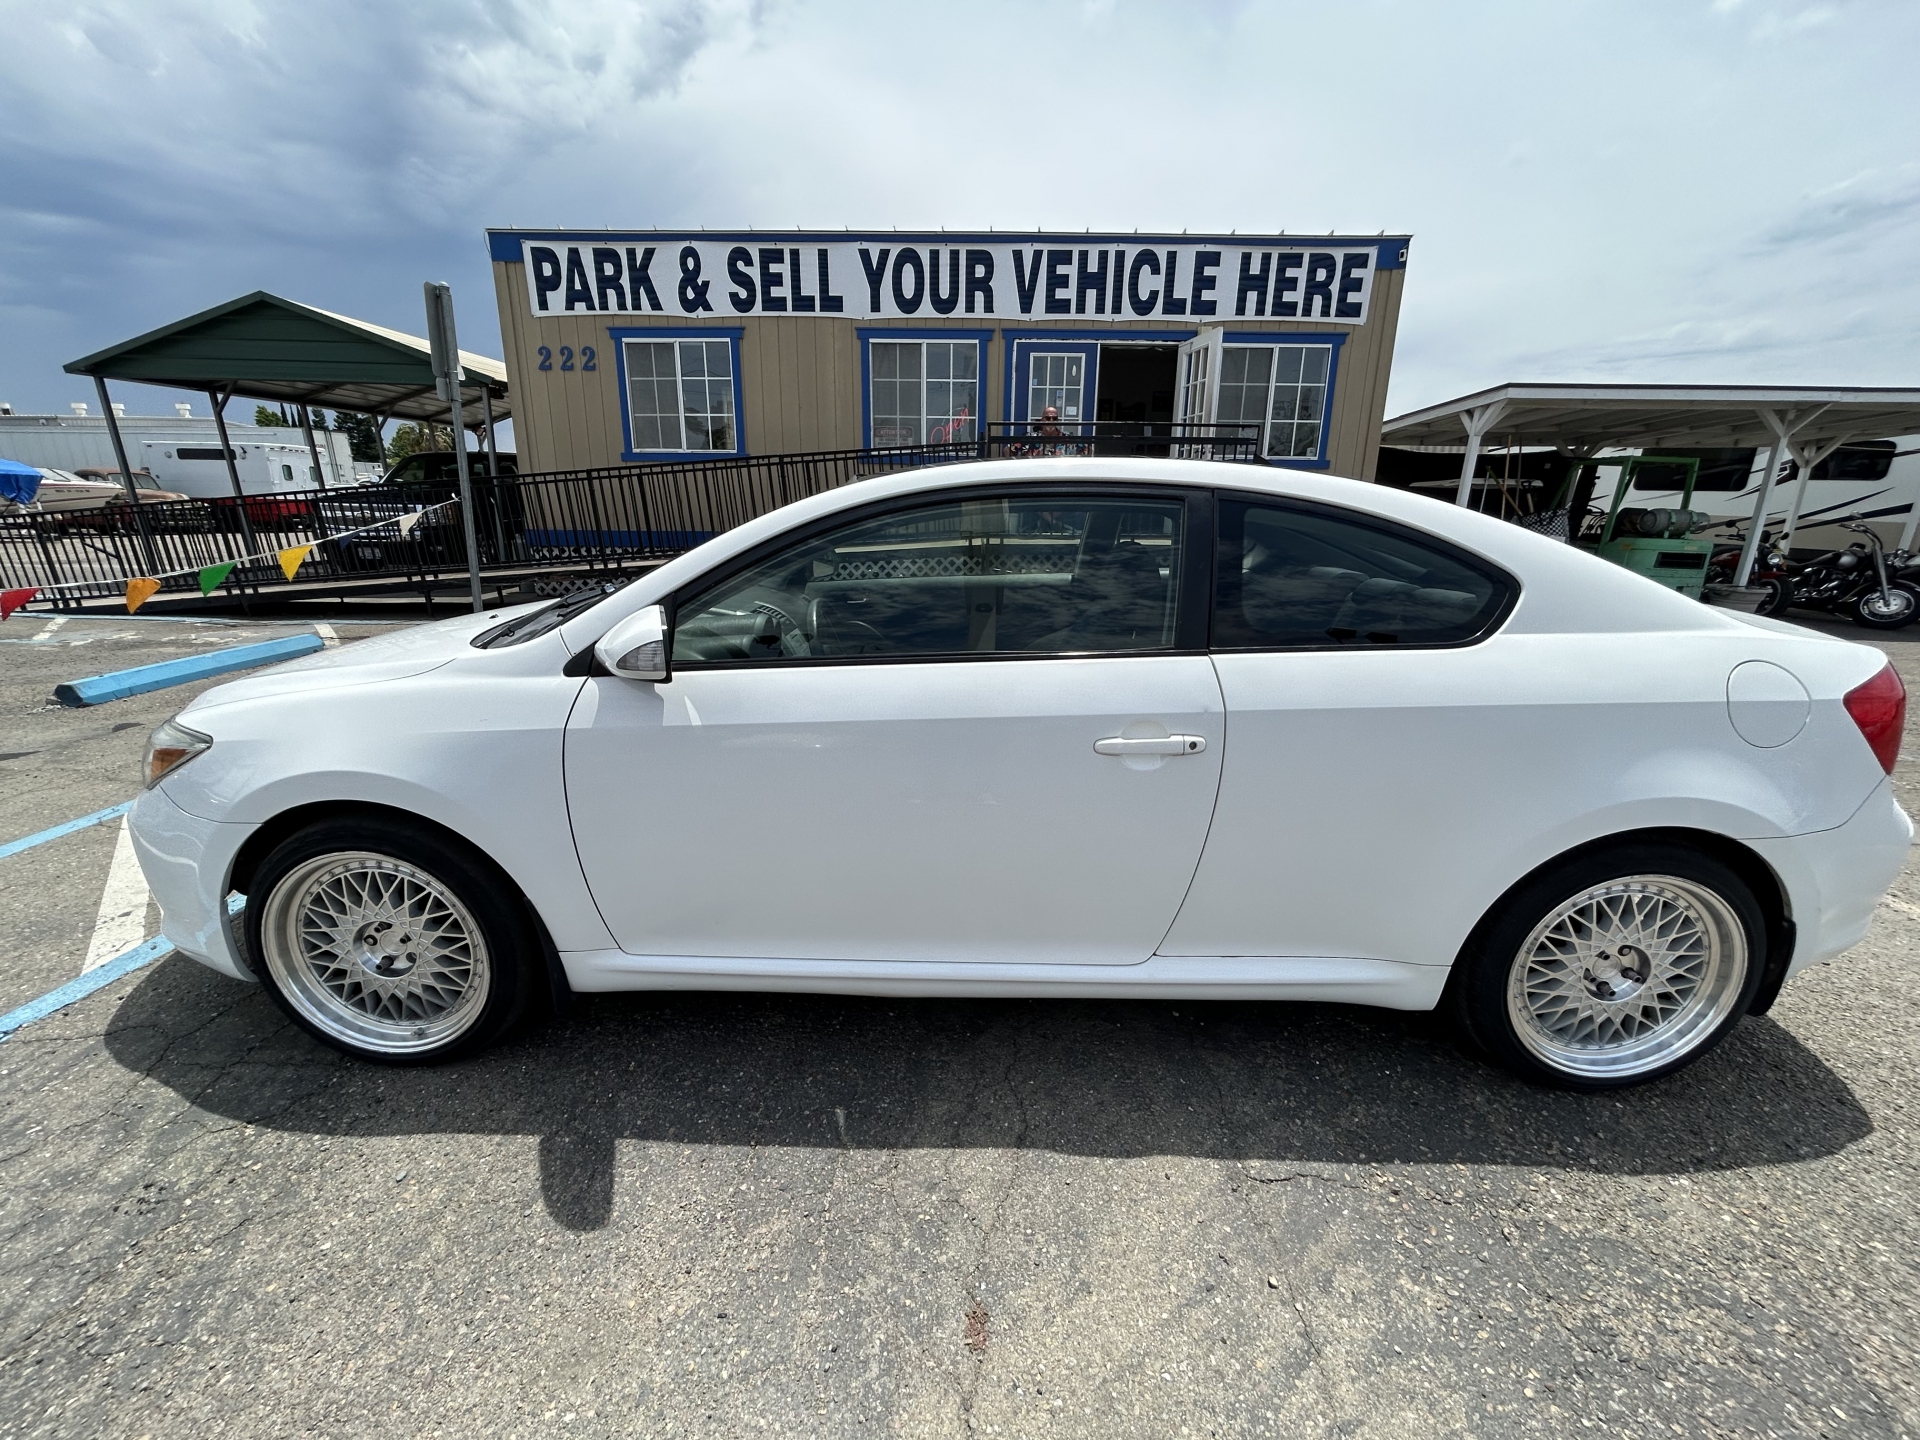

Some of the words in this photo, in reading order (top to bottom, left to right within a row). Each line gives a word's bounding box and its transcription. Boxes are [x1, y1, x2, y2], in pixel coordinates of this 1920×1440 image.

[530, 246, 664, 312] PARK
[678, 246, 714, 314] &
[727, 246, 844, 313] SELL
[858, 247, 995, 315] YOUR
[1012, 248, 1222, 317] VEHICLE
[1235, 252, 1370, 319] HERE
[537, 345, 596, 371] 222
